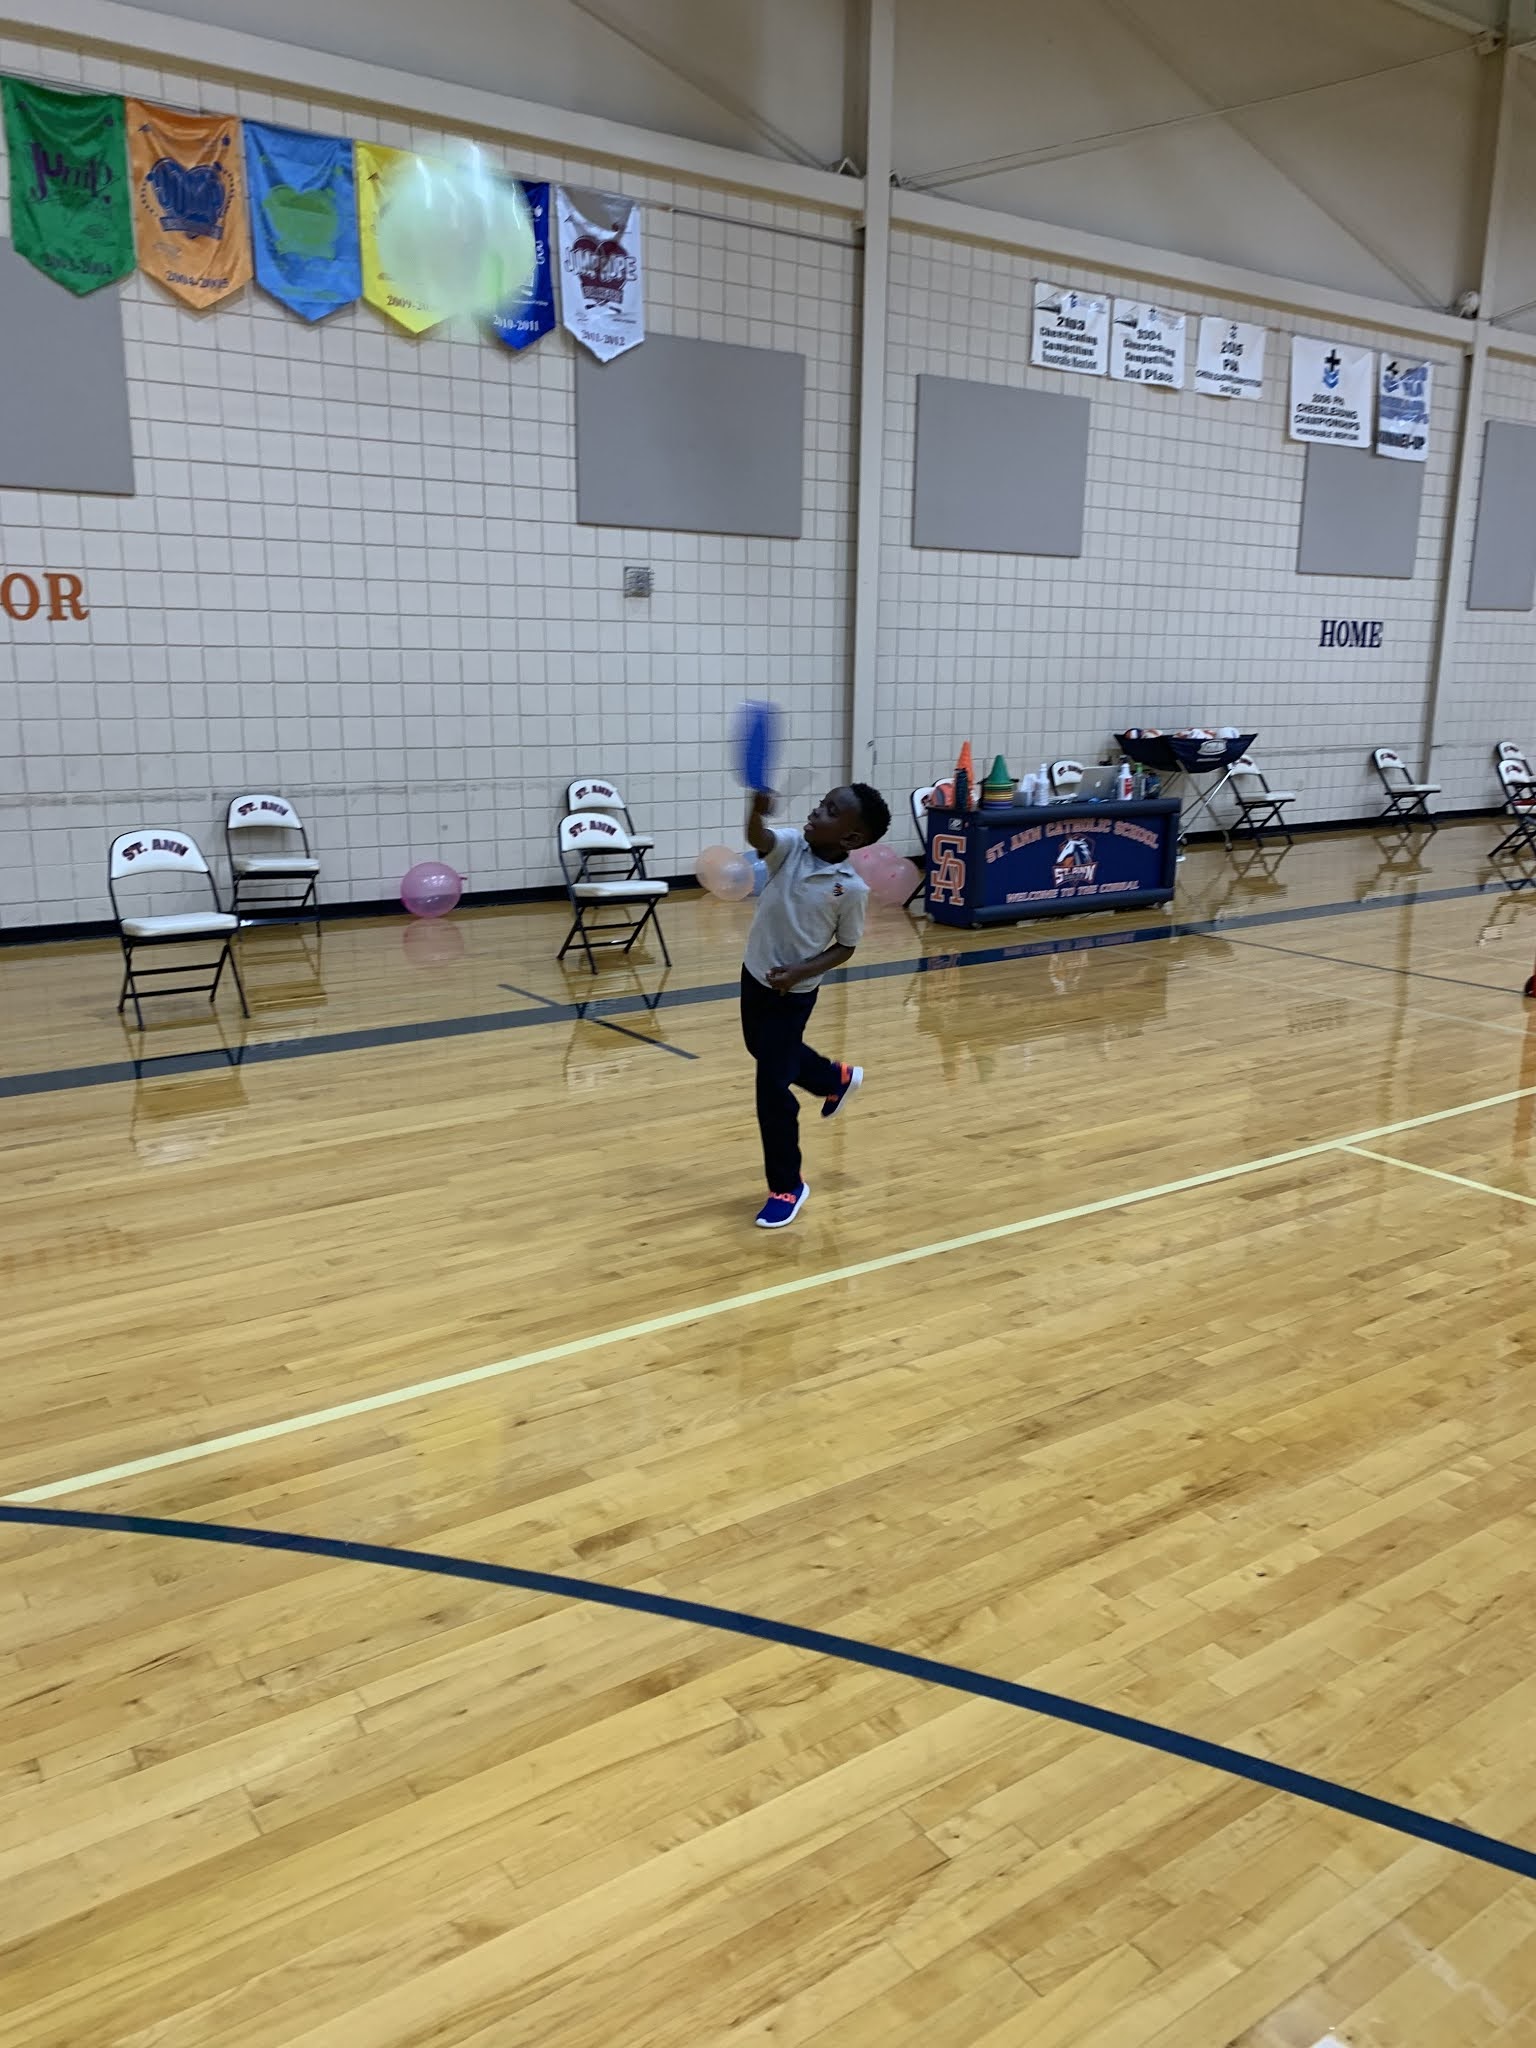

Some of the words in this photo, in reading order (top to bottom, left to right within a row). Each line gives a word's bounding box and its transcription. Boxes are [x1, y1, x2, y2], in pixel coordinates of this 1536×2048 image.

[0, 572, 90, 621] OR
[1317, 619, 1384, 648] HOME
[591, 785, 614, 798] ANN
[237, 802, 258, 816] ST.
[260, 800, 289, 816] ANN
[568, 822, 588, 838] ST.
[588, 820, 617, 836] ANN
[121, 841, 149, 862] ST.
[151, 838, 189, 857] ANN
[985, 841, 1009, 865] ST.
[1009, 825, 1043, 852] ANN
[1044, 817, 1113, 839] CATHOLIC
[1112, 820, 1160, 850] SCHOOL
[1006, 888, 1060, 904] WELCOME
[1060, 886, 1077, 898] TO
[1077, 884, 1099, 896] THE
